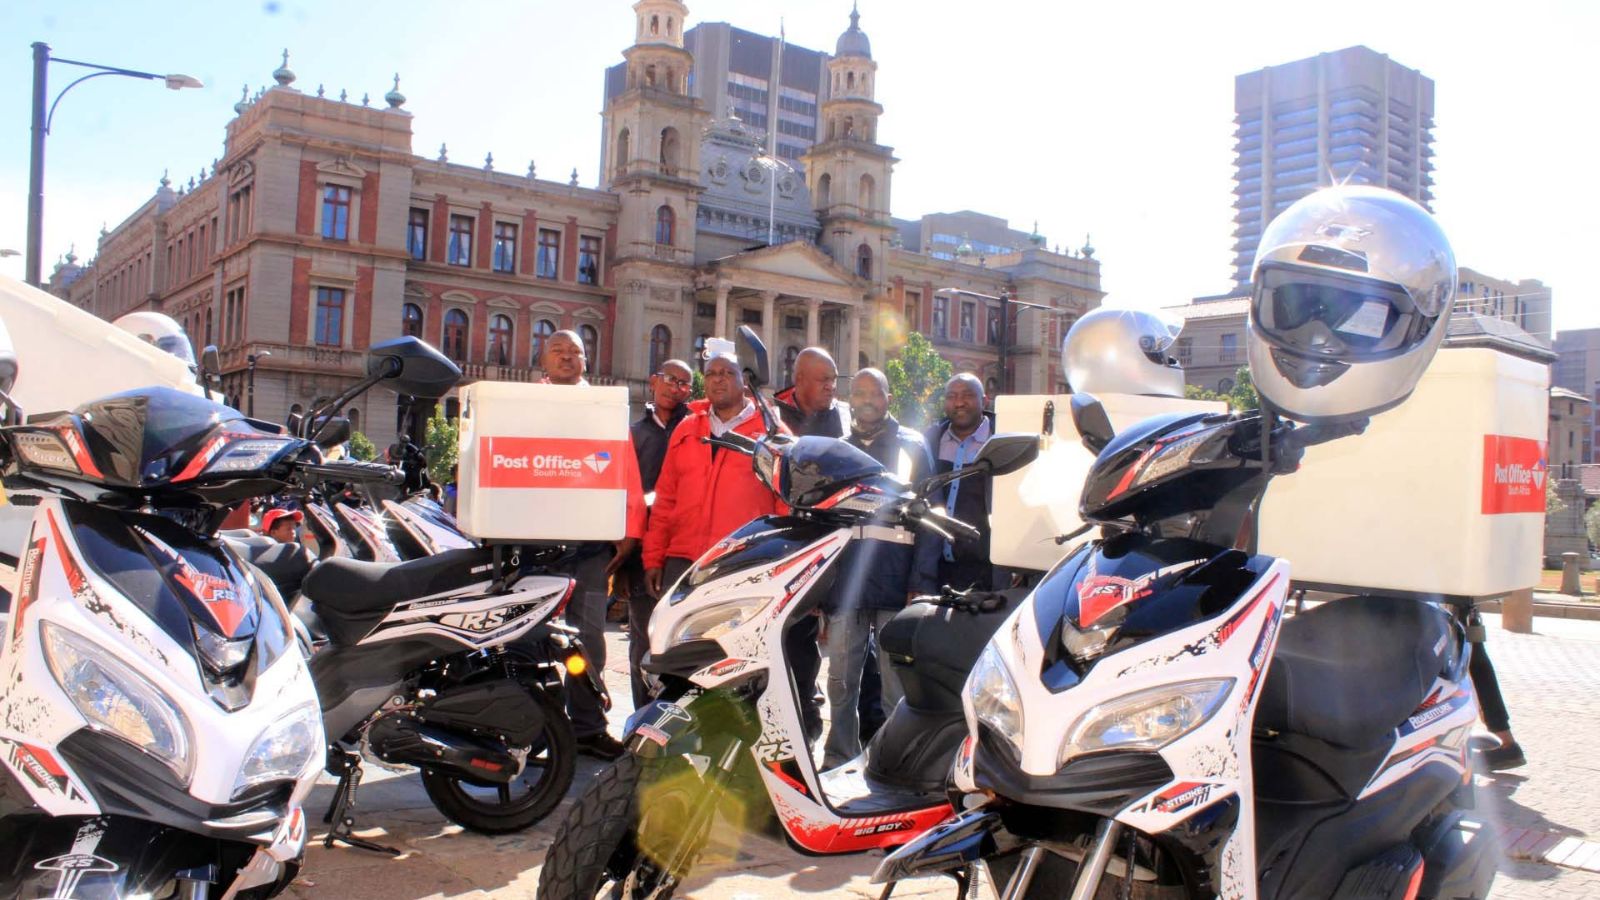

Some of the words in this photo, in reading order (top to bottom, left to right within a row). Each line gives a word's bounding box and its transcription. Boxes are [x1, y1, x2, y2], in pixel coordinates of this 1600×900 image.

[493, 454, 528, 468] Post
[533, 454, 582, 469] Office
[533, 469, 556, 477] South
[559, 469, 582, 478] Africa
[1494, 463, 1508, 484] Post
[1508, 463, 1531, 484] Office
[461, 607, 508, 631] RS
[854, 826, 875, 836] BIG
[877, 822, 902, 833] BOY
